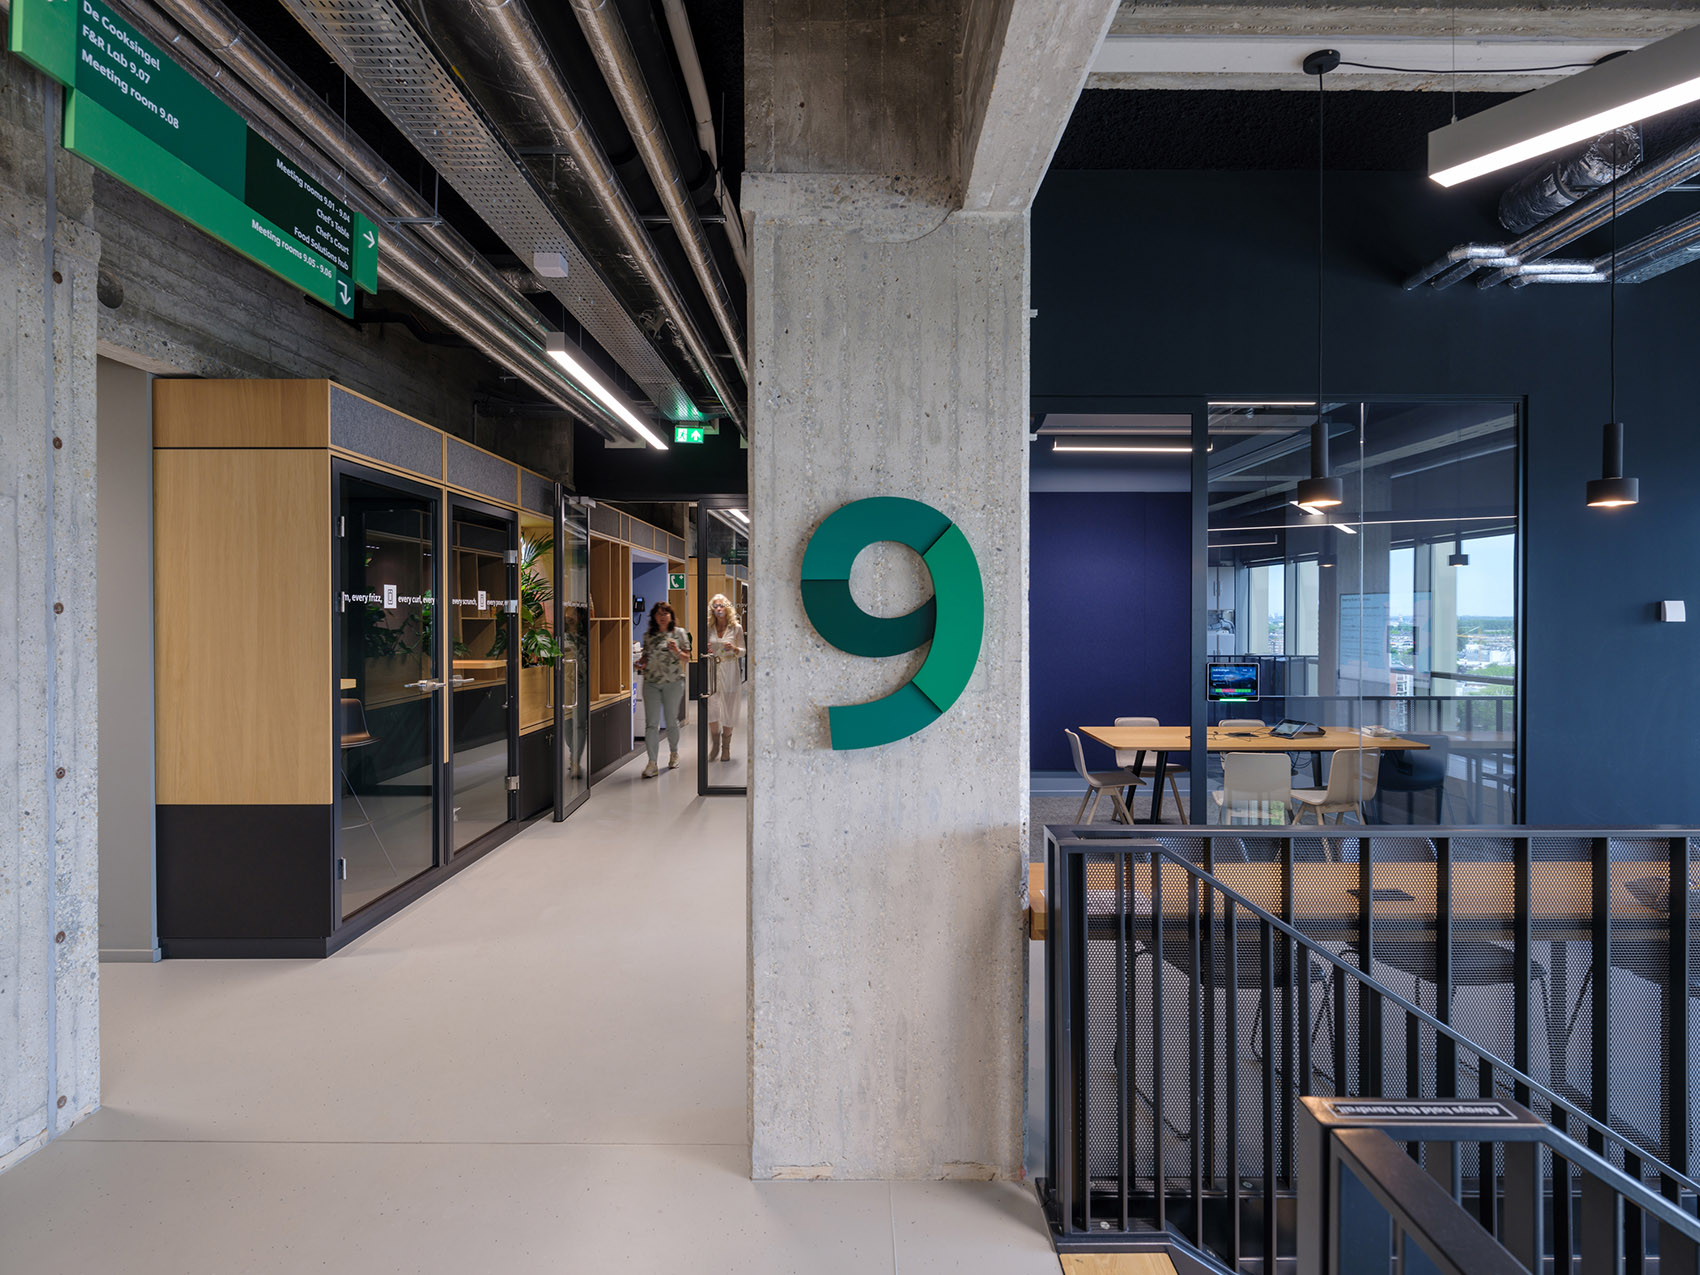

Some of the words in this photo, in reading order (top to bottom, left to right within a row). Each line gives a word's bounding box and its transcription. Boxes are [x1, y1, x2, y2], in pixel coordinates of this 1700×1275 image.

[82, 25, 105, 50] F&R
[107, 43, 128, 68] Lab
[130, 62, 151, 84] 9.07
[83, 1, 99, 21] De
[101, 16, 161, 71] Cooksingel
[82, 49, 128, 94] Meeting
[130, 87, 157, 114] room
[159, 108, 179, 129] 9.08
[276, 158, 303, 188] Meeting
[304, 182, 323, 202] rooms
[323, 196, 335, 211] 9.01
[339, 206, 350, 223] 9.04
[315, 224, 333, 244] Chef's
[334, 237, 350, 255] Court
[316, 208, 334, 228] Chef's
[335, 221, 350, 239] Table
[252, 219, 281, 247] Meeting
[281, 238, 303, 260] rooms
[303, 252, 316, 269] 9.05
[320, 264, 332, 279] 9.06
[294, 226, 310, 244] Food
[311, 237, 337, 263] Solutions
[338, 256, 349, 270] hub
[352, 593, 368, 604] every
[369, 593, 383, 604] frizz,
[398, 595, 411, 605] every
[801, 496, 984, 750] 9
[1396, 1106, 1421, 1115] the
[1421, 1106, 1453, 1115] hold
[1453, 1106, 1500, 1115] Always
